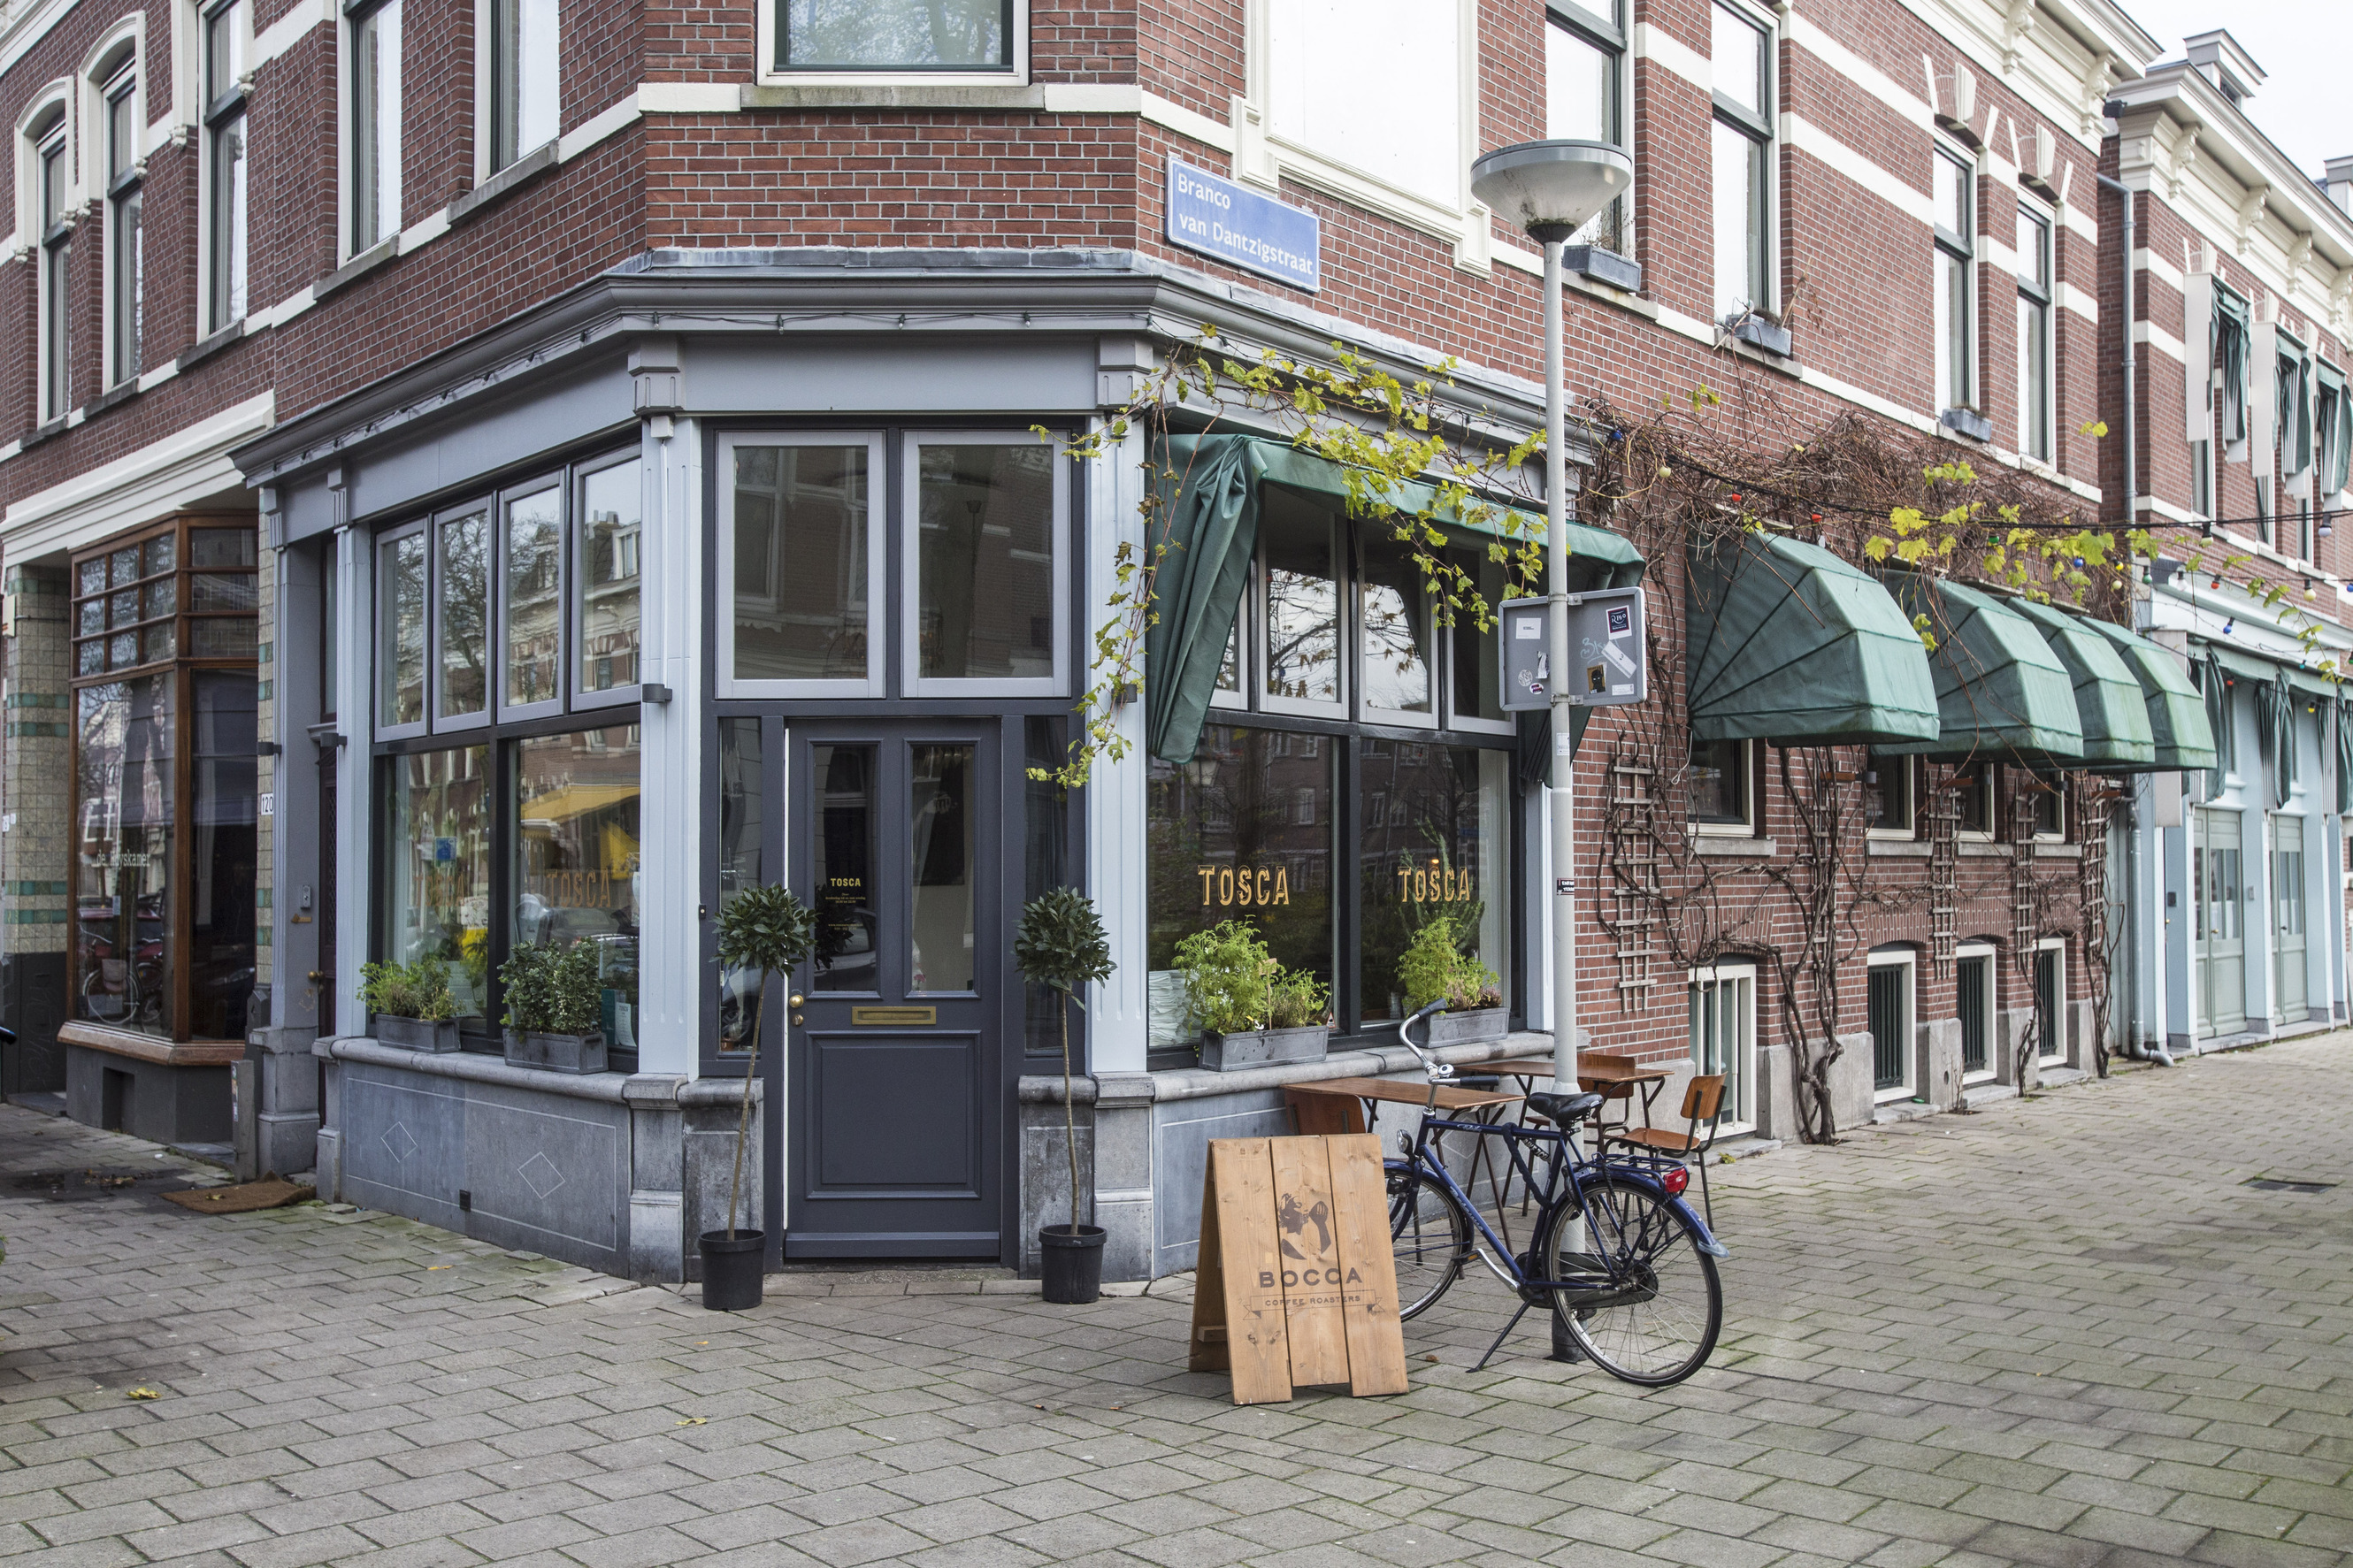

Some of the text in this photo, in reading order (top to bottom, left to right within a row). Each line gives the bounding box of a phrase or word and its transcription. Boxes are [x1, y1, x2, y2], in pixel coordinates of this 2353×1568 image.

[1177, 172, 1230, 210] Branco
[1178, 213, 1313, 275] van Dantzigstraat
[261, 796, 273, 813] 120
[414, 872, 464, 906] TOSCA
[546, 868, 611, 908] TOSCA
[830, 877, 862, 887] TOSCA
[1198, 865, 1290, 906] TOSCA
[1397, 866, 1470, 903] TOSCA
[1259, 1267, 1362, 1289] BOCCA
[1310, 1296, 1360, 1304] ROASTERS
